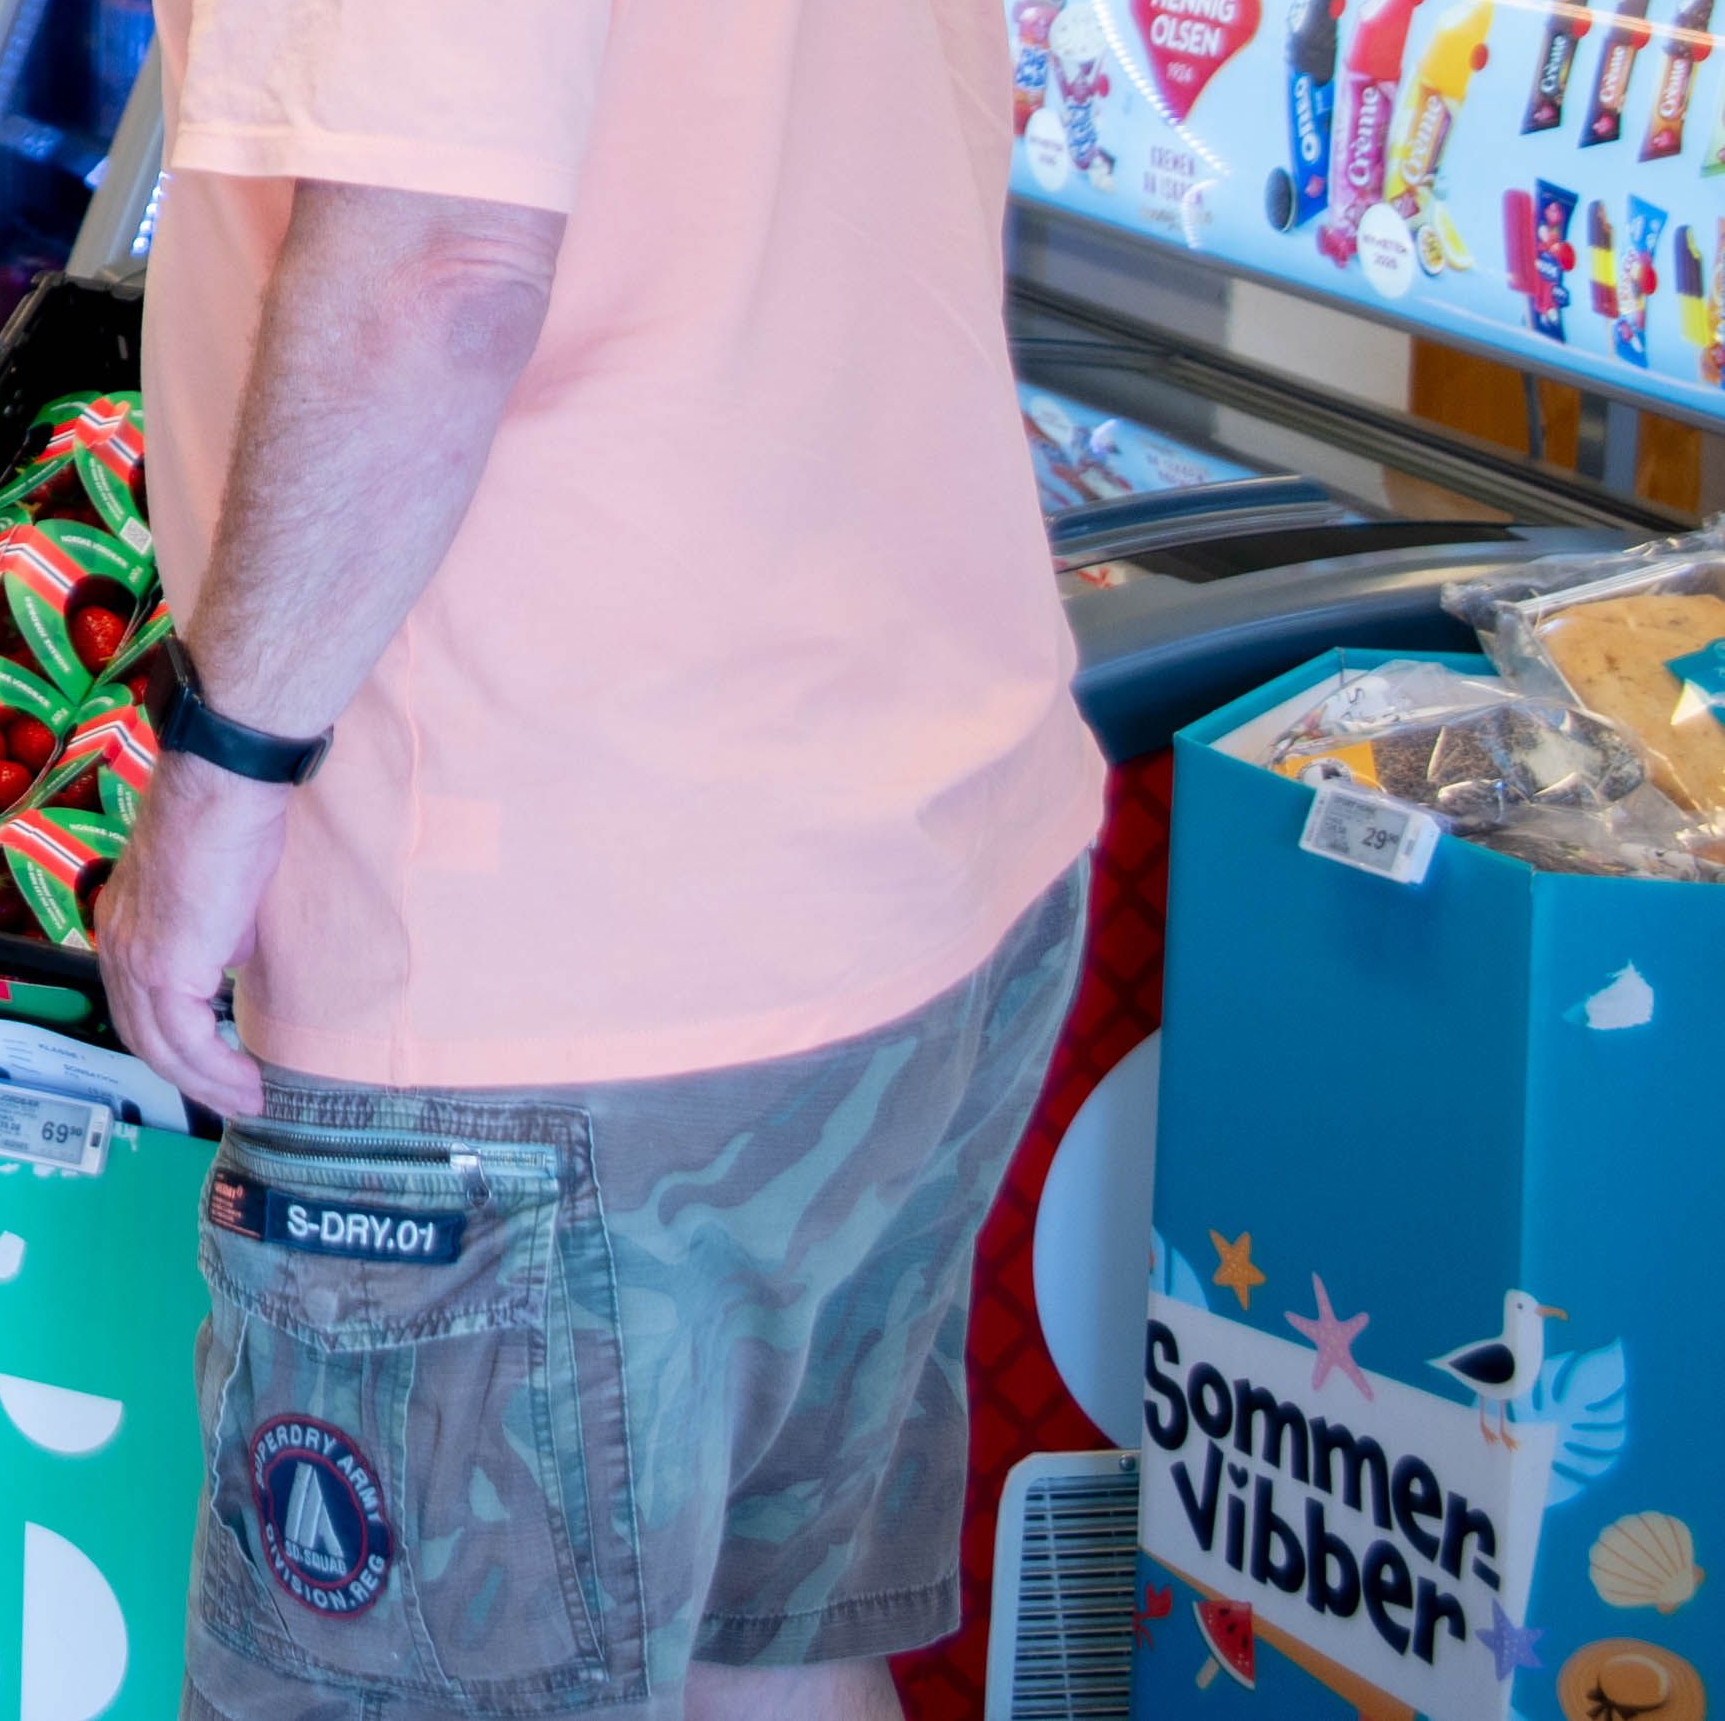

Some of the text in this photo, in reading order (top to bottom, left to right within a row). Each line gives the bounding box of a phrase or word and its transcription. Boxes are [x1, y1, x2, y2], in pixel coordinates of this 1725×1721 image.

[1150, 13, 1222, 58] OLSEN
[1295, 75, 1320, 164] OREO
[1361, 827, 1388, 850] 29
[41, 1121, 69, 1144] 69
[287, 1204, 434, 1252] S-DRY.01
[1143, 1318, 1502, 1593] Sommer-
[336, 1454, 383, 1525] ARMY
[1169, 1438, 1467, 1666] Vibber
